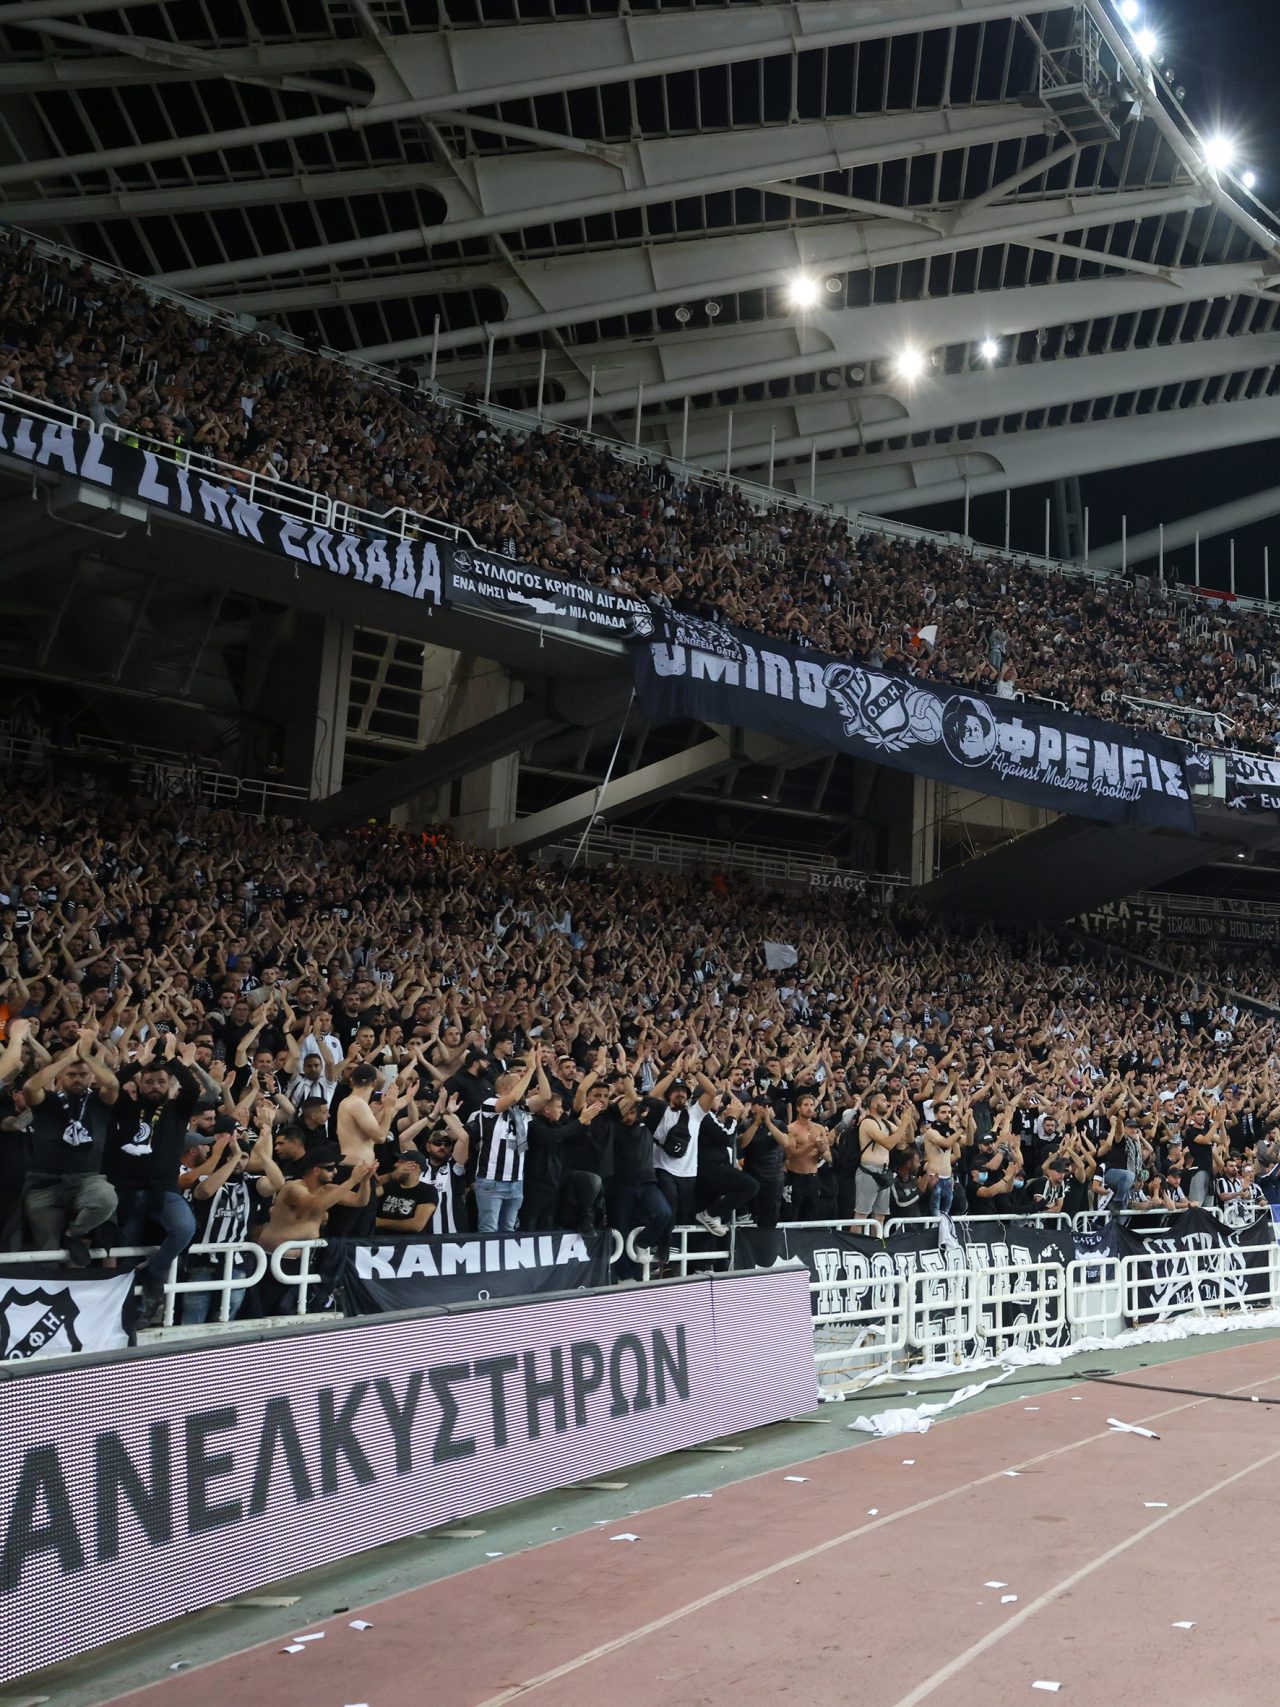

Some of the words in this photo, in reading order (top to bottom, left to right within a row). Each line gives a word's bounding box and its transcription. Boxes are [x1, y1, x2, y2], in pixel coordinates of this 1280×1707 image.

[453, 575, 476, 592] ΕΝΑ
[478, 581, 504, 599] ΝΗΣΙ
[569, 605, 588, 620] ΜΙΑ
[589, 609, 627, 629] ΟΜΑΔΑ
[473, 559, 542, 590] ΣΥΛΛΟΓΟΣ
[544, 578, 594, 603] ΚΡΗΤΩΝ
[991, 752, 1040, 780] Against
[1041, 765, 1089, 793] Modern
[1091, 777, 1142, 802] Football
[809, 872, 866, 892] BLACK
[355, 1233, 590, 1280] KAMINIA
[1143, 1230, 1249, 1296] ULTRAS
[0, 1324, 690, 1591] ΑΝΕΛΚΥΣΤΗΡΩΝ
